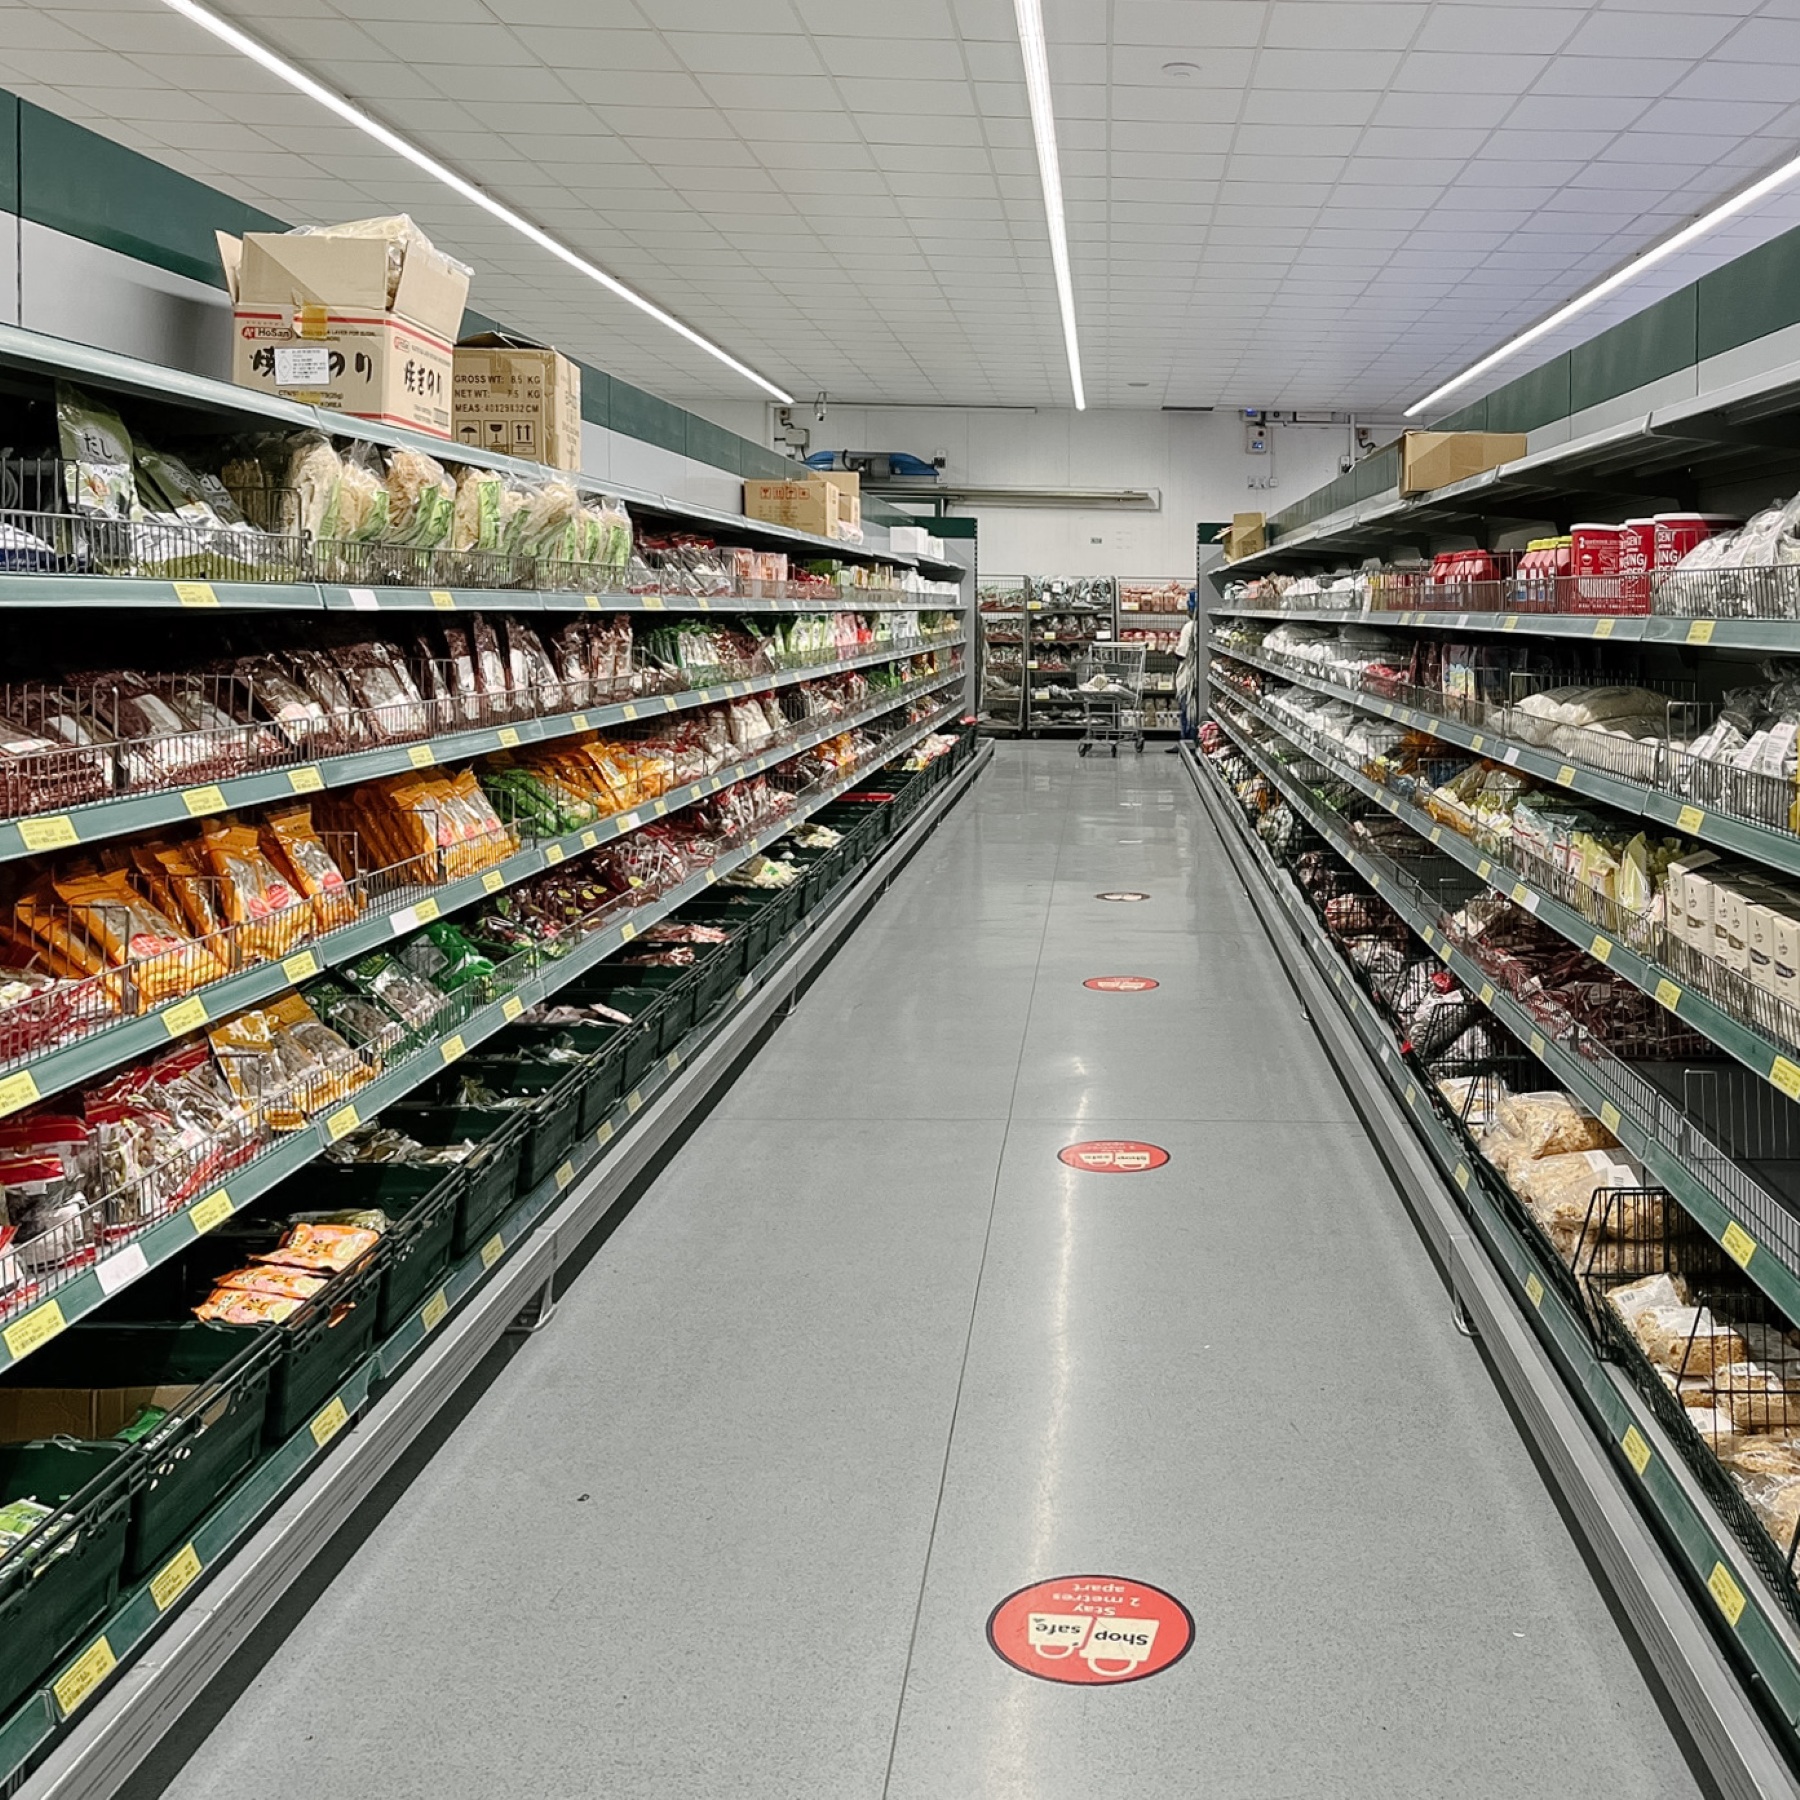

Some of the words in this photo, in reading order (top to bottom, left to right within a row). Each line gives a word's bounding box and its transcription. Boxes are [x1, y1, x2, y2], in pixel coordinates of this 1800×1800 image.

[257, 328, 290, 338] HoSan
[454, 375, 487, 384] GROSS
[487, 375, 505, 384] WT:
[527, 375, 541, 384] KG
[454, 389, 472, 398] NET
[474, 389, 490, 398] WT:
[527, 389, 541, 399] KG
[84, 432, 112, 459] だし
[1072, 1583, 1125, 1594] apart
[1052, 1593, 1124, 1604] metres
[1130, 1597, 1141, 1607] 2
[1072, 1605, 1116, 1616] Stay
[1035, 1622, 1081, 1635] safe
[1094, 1630, 1149, 1646] Shop
